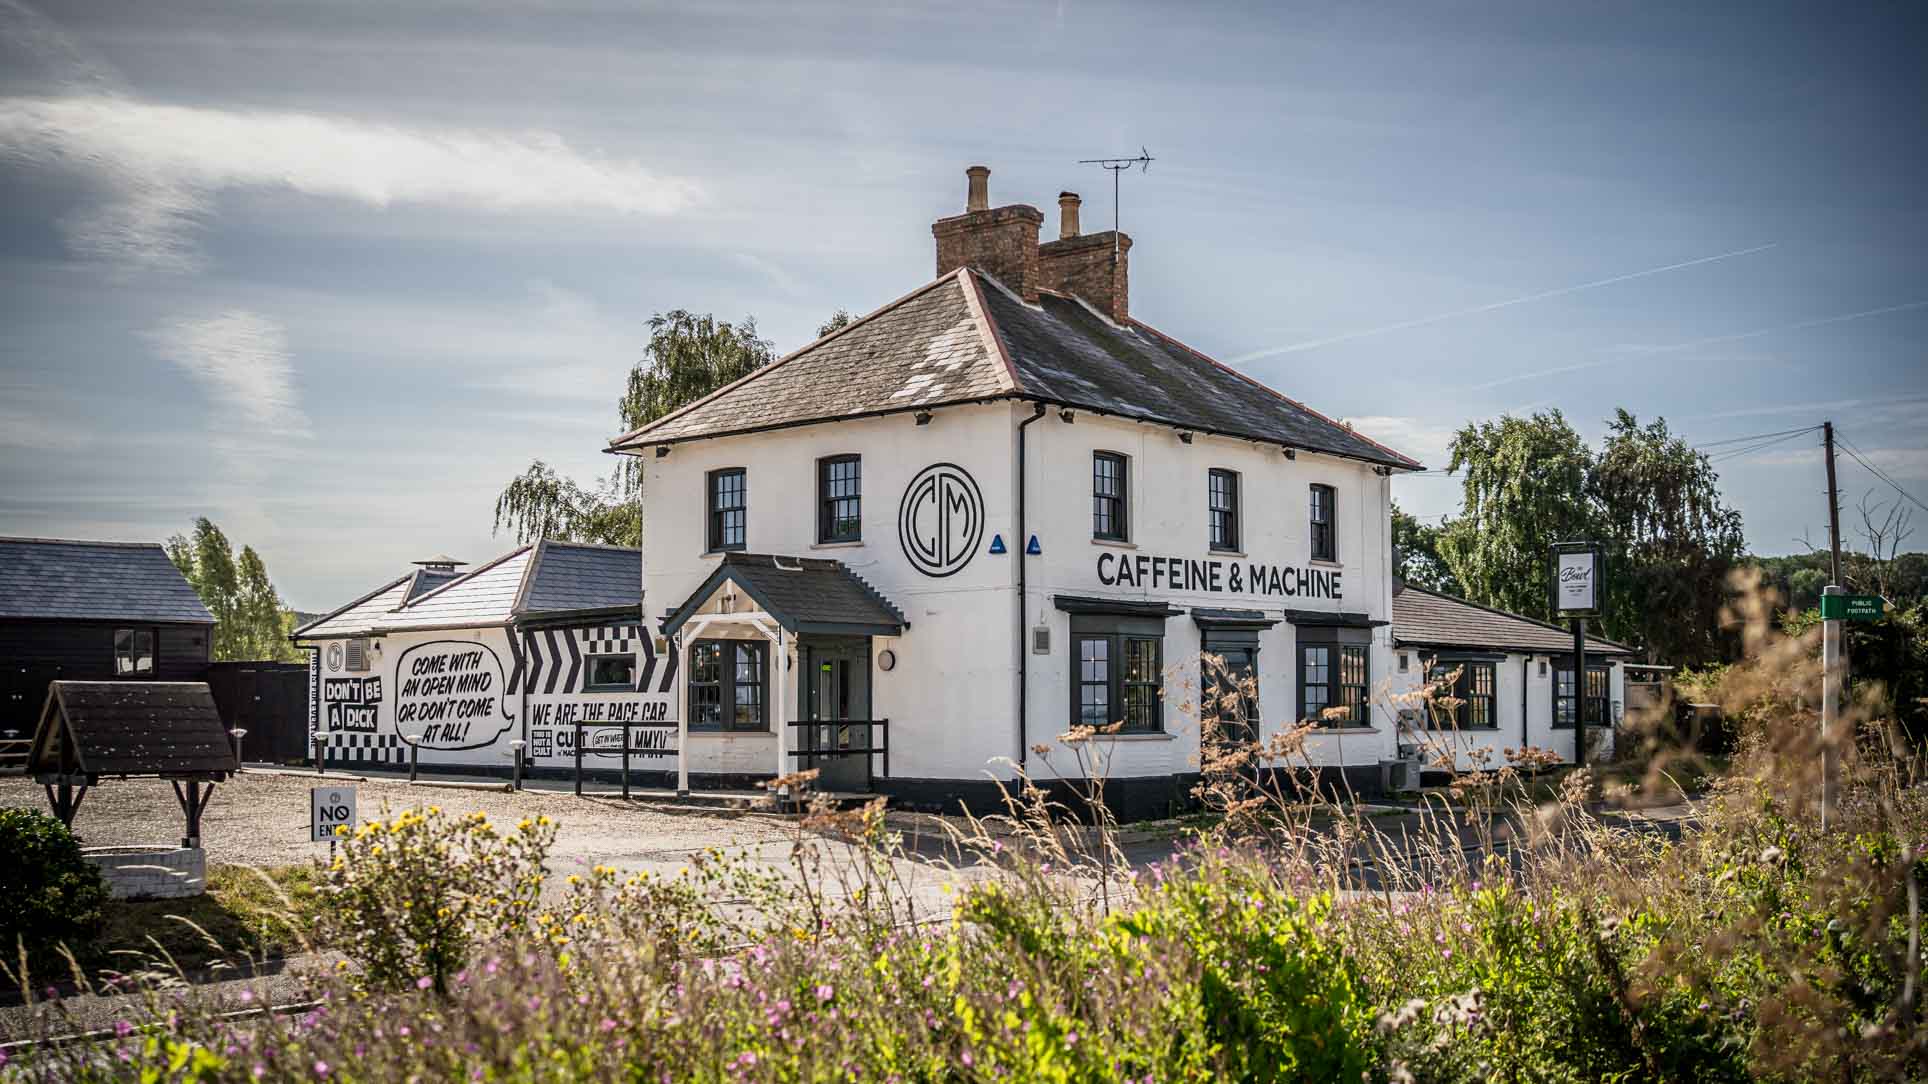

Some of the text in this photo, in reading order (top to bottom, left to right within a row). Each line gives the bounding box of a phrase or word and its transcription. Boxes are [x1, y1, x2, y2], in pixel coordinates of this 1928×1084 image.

[1097, 552, 1343, 599] CAFFEINE & MACHINE
[412, 650, 483, 676] COME WITH
[326, 679, 381, 700] DON'T BE
[402, 671, 492, 697] AN OPEN MIND
[331, 708, 376, 729] A D!CK
[398, 697, 495, 722] OR DON'T COME
[532, 702, 668, 726] WE ARE THE PACE CAR
[422, 721, 471, 743] AT ALL!
[556, 731, 589, 747] CUT
[320, 805, 350, 822] NO
